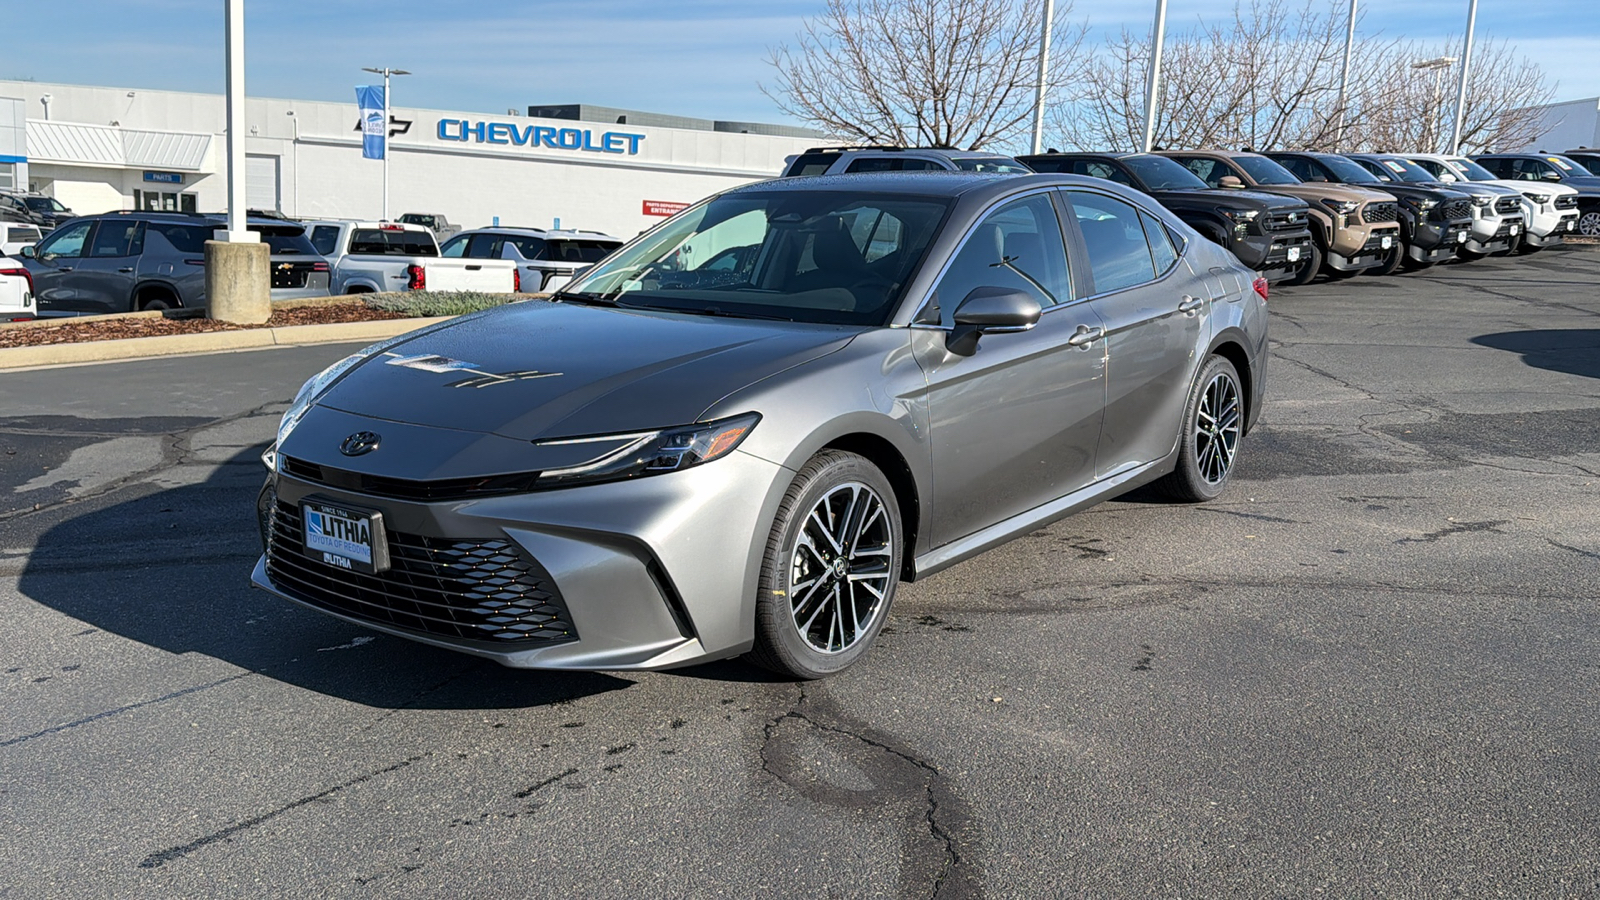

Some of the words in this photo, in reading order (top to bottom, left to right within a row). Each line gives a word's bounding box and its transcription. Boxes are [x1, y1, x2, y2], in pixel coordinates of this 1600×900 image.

[437, 118, 646, 155] CHEVROLET
[153, 174, 172, 182] PARTS
[321, 506, 335, 515] SINCE
[321, 515, 370, 546] LITHIA
[309, 534, 332, 547] TOYOTA
[333, 540, 343, 548] OF
[344, 541, 370, 557] REDDING
[330, 554, 352, 569] LITHIA
